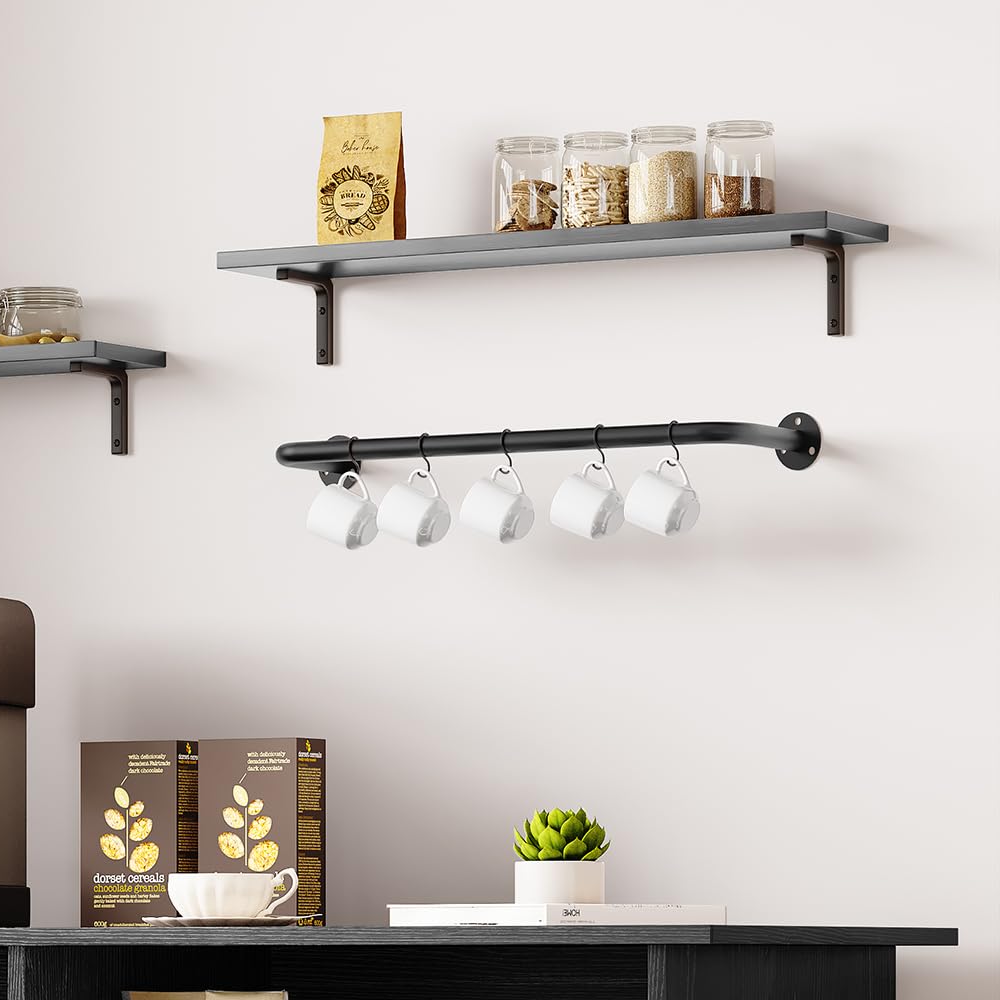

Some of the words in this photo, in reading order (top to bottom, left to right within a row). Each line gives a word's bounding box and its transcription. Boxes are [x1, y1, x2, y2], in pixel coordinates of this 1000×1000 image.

[93, 872, 126, 884] dorset
[128, 872, 165, 884] cereals
[93, 884, 133, 893] chocolate
[134, 883, 166, 894] granola
[562, 909, 581, 917] HOME
